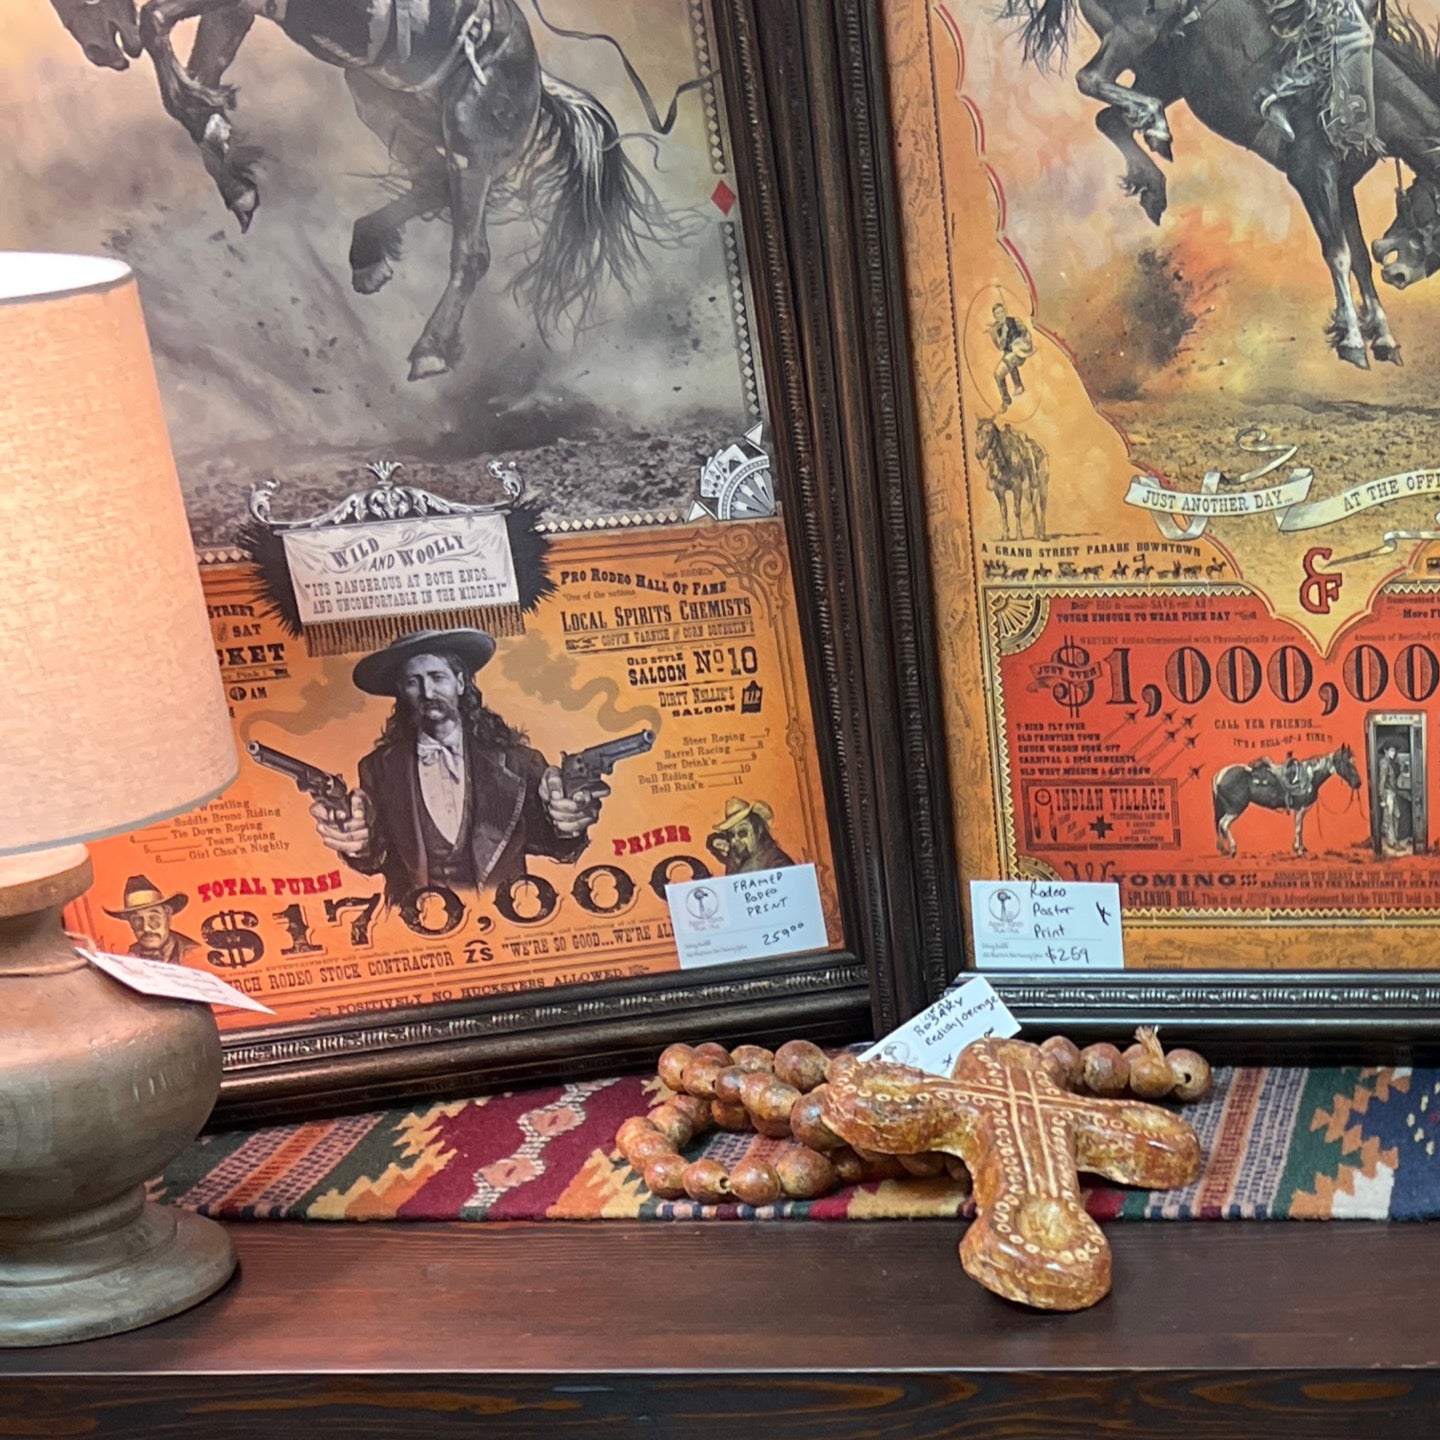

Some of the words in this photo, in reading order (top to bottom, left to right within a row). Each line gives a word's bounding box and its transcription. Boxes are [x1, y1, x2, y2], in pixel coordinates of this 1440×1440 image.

[1142, 490, 1177, 510] JUST
[1181, 496, 1250, 514] ANOTHER
[1343, 492, 1361, 512] AT
[1366, 479, 1400, 502] THE
[330, 537, 380, 569] WILD
[369, 554, 396, 572] AND
[396, 535, 466, 567] WOOLLY
[981, 543, 989, 553] A
[995, 545, 1033, 558] GRAND
[1038, 545, 1079, 558] STREET
[1086, 542, 1130, 555] PARADE
[1136, 542, 1202, 557] DOWNTOWN
[335, 578, 402, 596] DANGEROUS
[407, 574, 421, 588] AT
[425, 571, 455, 585] BOTH
[560, 571, 587, 585] PRO
[590, 568, 632, 586] RODEO
[636, 574, 669, 593] HALL
[673, 581, 689, 595] OF
[693, 581, 727, 595] FAME
[313, 600, 334, 614] AND
[337, 592, 419, 613] UNCOMFORTABLE
[422, 590, 433, 604] IN
[435, 588, 455, 602] THE
[207, 604, 255, 619] STREET
[560, 610, 608, 632] LOCAL
[614, 604, 672, 627] SPIRITS
[679, 597, 752, 621] CHEMISTS
[1150, 612, 1175, 622] WEAR
[1178, 612, 1207, 622] PINK
[1403, 608, 1427, 619] More
[232, 624, 261, 637] SAT
[626, 656, 649, 666] OLD
[651, 652, 684, 664] STYLE
[628, 664, 687, 686] SALOON
[250, 687, 267, 700] AM
[658, 690, 688, 707] DIRTY
[672, 704, 736, 717] SALOON
[1214, 719, 1239, 730] CALL
[1244, 719, 1260, 730] YER
[683, 735, 707, 747] Steer
[711, 732, 745, 745] Roping
[664, 748, 695, 759] Barrel
[698, 745, 730, 757] Racing
[638, 775, 658, 785] Bull
[662, 771, 694, 784] Riding
[651, 784, 671, 794] Hell
[1055, 788, 1103, 812] INDIAN
[1109, 788, 1166, 811] VILLAGE
[174, 815, 208, 828] Saddle
[246, 807, 281, 821] Riding
[171, 829, 188, 840] Tie
[192, 826, 221, 838] Down
[225, 821, 263, 836] Roping
[205, 836, 235, 848] Team
[238, 831, 276, 846] Roping
[612, 824, 692, 857] PRIZES
[188, 849, 210, 861] Girl
[251, 840, 290, 855] Nightly
[198, 876, 267, 903] TOTAL
[271, 870, 342, 896] PURSE
[733, 871, 783, 894] FRAMED
[1029, 879, 1067, 899] Rodeo
[1128, 890, 1172, 907] SPLENDID
[1033, 923, 1066, 940] Print
[270, 972, 314, 990] RODEO
[320, 965, 361, 983] STOCK
[369, 951, 455, 977] CONTRACTOR
[553, 936, 569, 952] SO
[337, 994, 423, 1015] POSITIVELY
[432, 990, 453, 1002] NO
[461, 977, 546, 999] HUCKSTERS
[554, 967, 625, 987] ALLOWED
